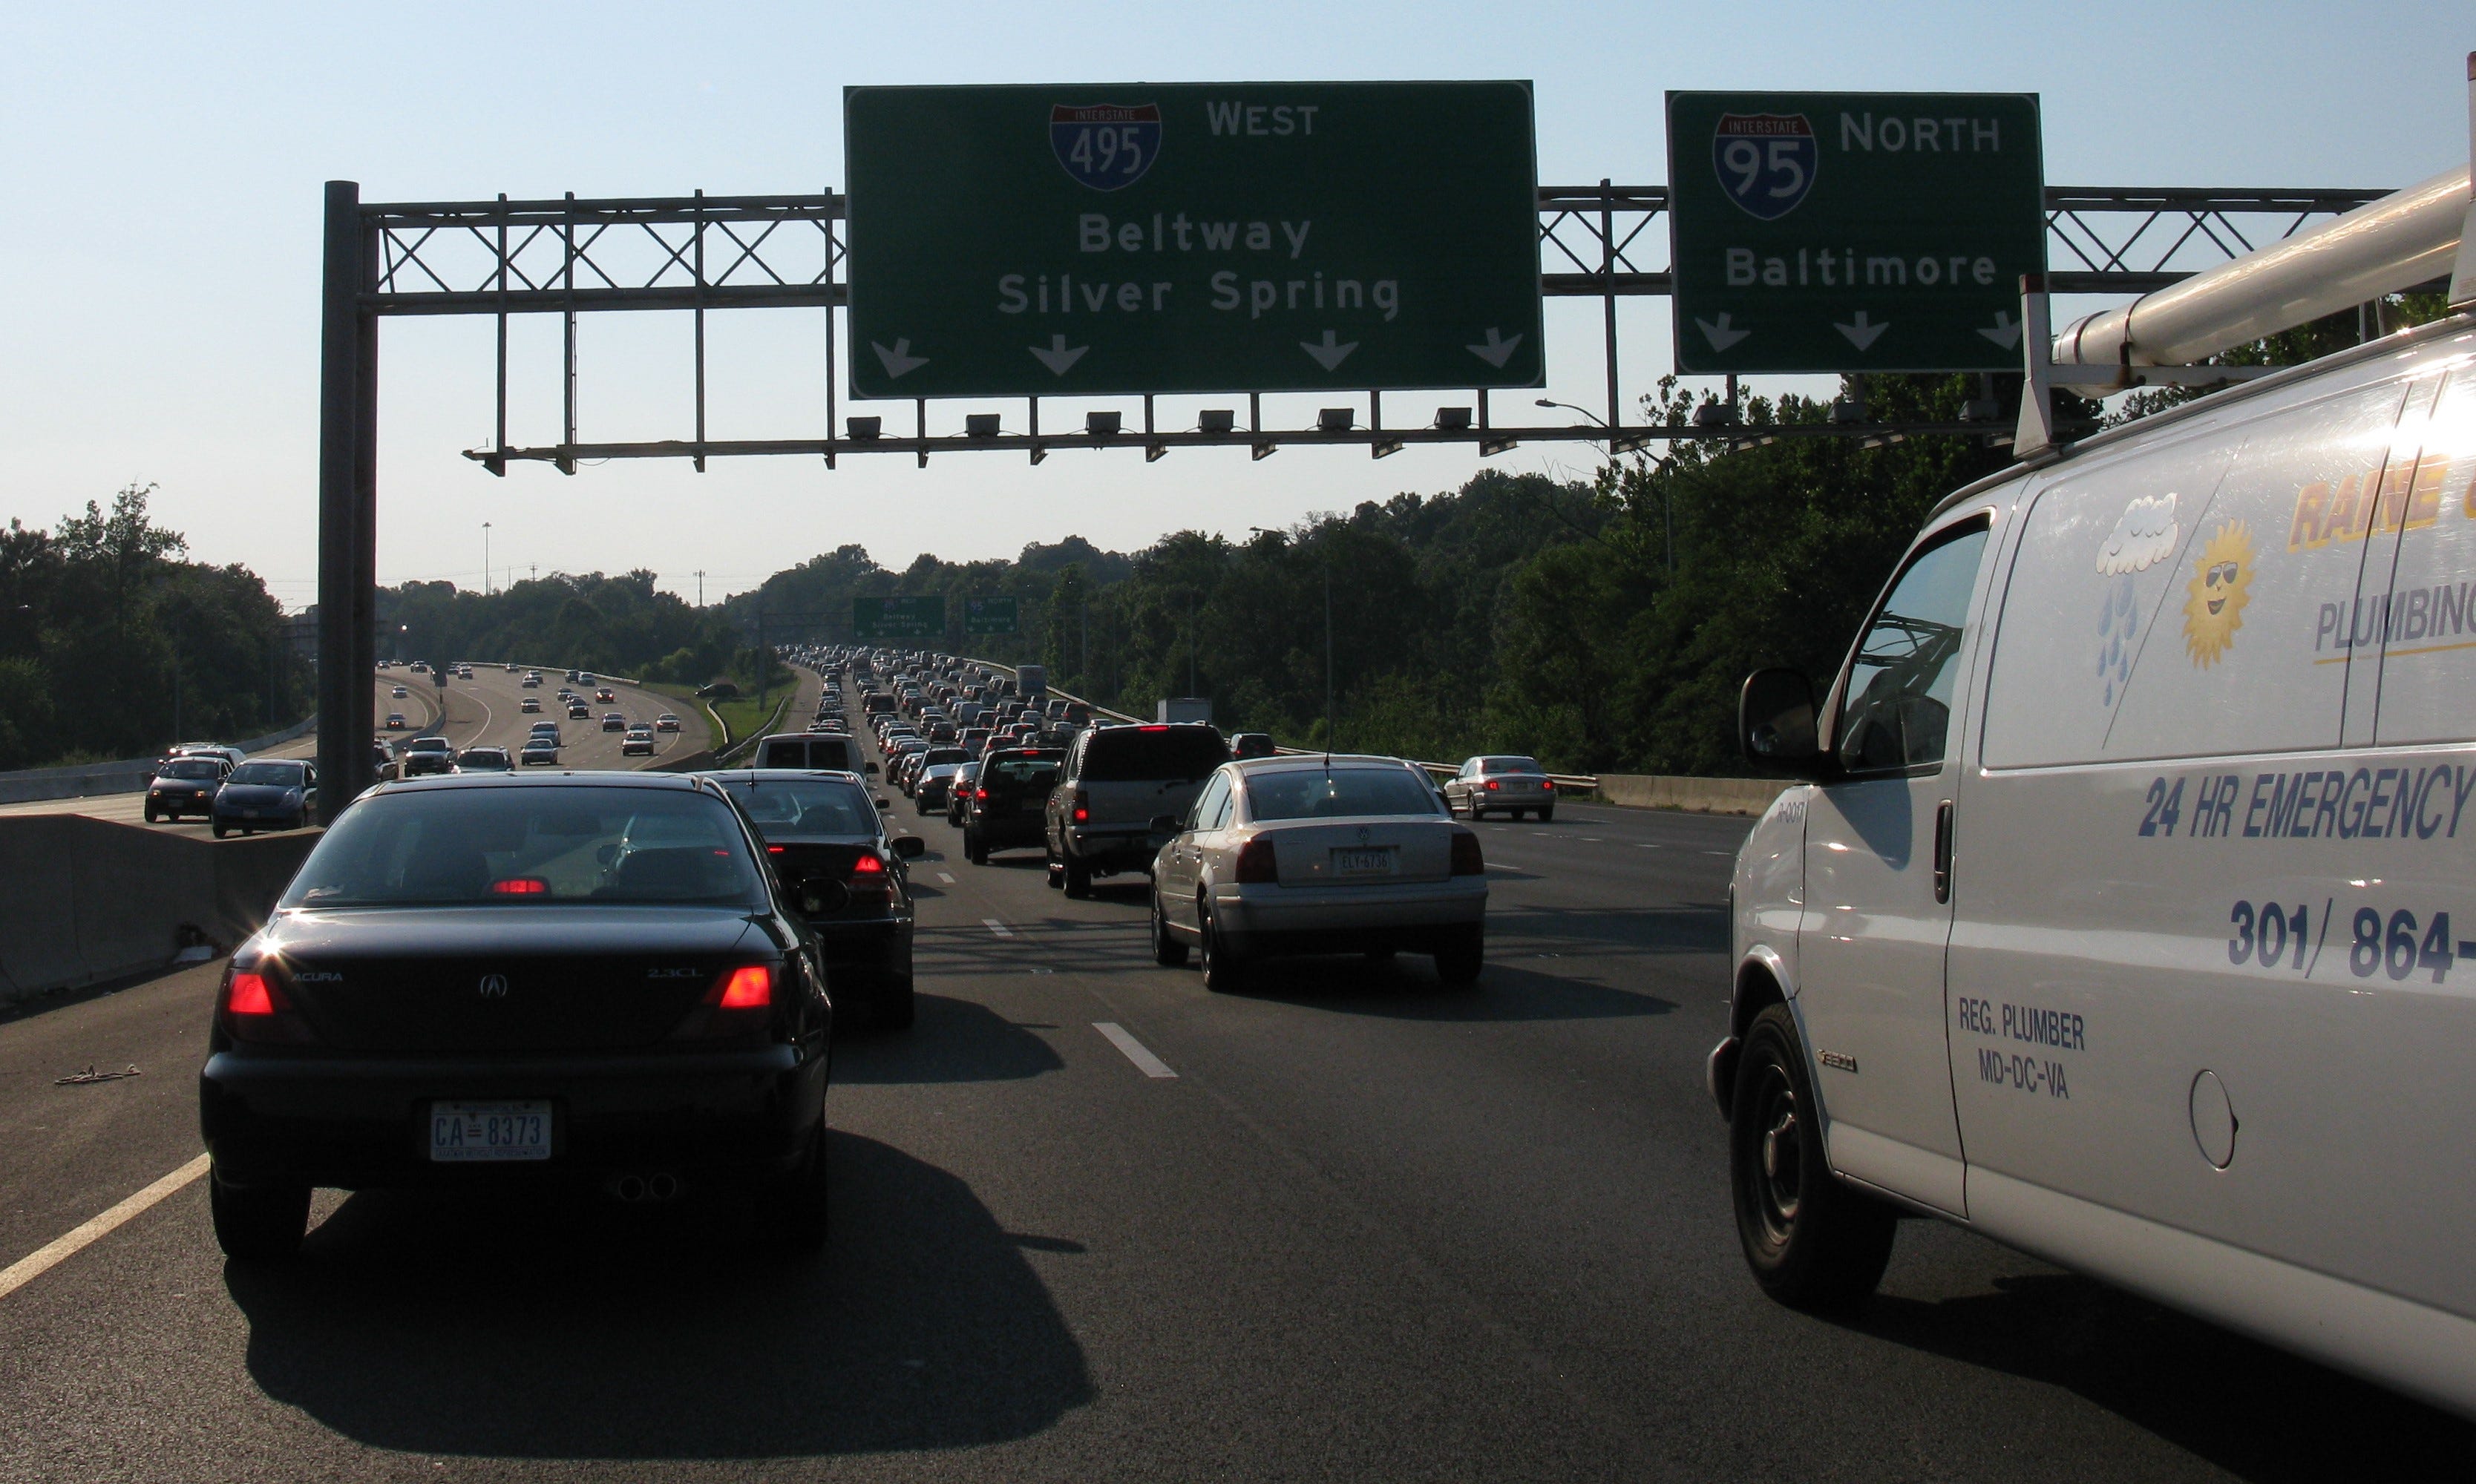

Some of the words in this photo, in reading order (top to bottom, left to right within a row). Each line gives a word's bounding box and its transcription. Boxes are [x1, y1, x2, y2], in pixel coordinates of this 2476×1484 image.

[1075, 109, 1136, 121] INTERSTATE
[1205, 101, 1319, 137] WEST
[1728, 120, 1799, 134] INTERSTATE
[1839, 112, 2000, 152] NORTH
[1070, 126, 1142, 174] 495
[1723, 139, 1804, 198] 95
[1078, 212, 1312, 259] Beltway
[1726, 247, 1997, 286] Baltimore
[997, 272, 1173, 314] Silver
[1210, 271, 1399, 321] Spring
[2138, 776, 2187, 837] 24
[2190, 775, 2240, 838] HR
[2241, 764, 2476, 840] EMERGENCY
[291, 972, 344, 982] ACURA
[1959, 997, 1997, 1035] REG.
[2002, 1002, 2086, 1051] PLUMBER
[1978, 1047, 2070, 1100] MD-DC-VA
